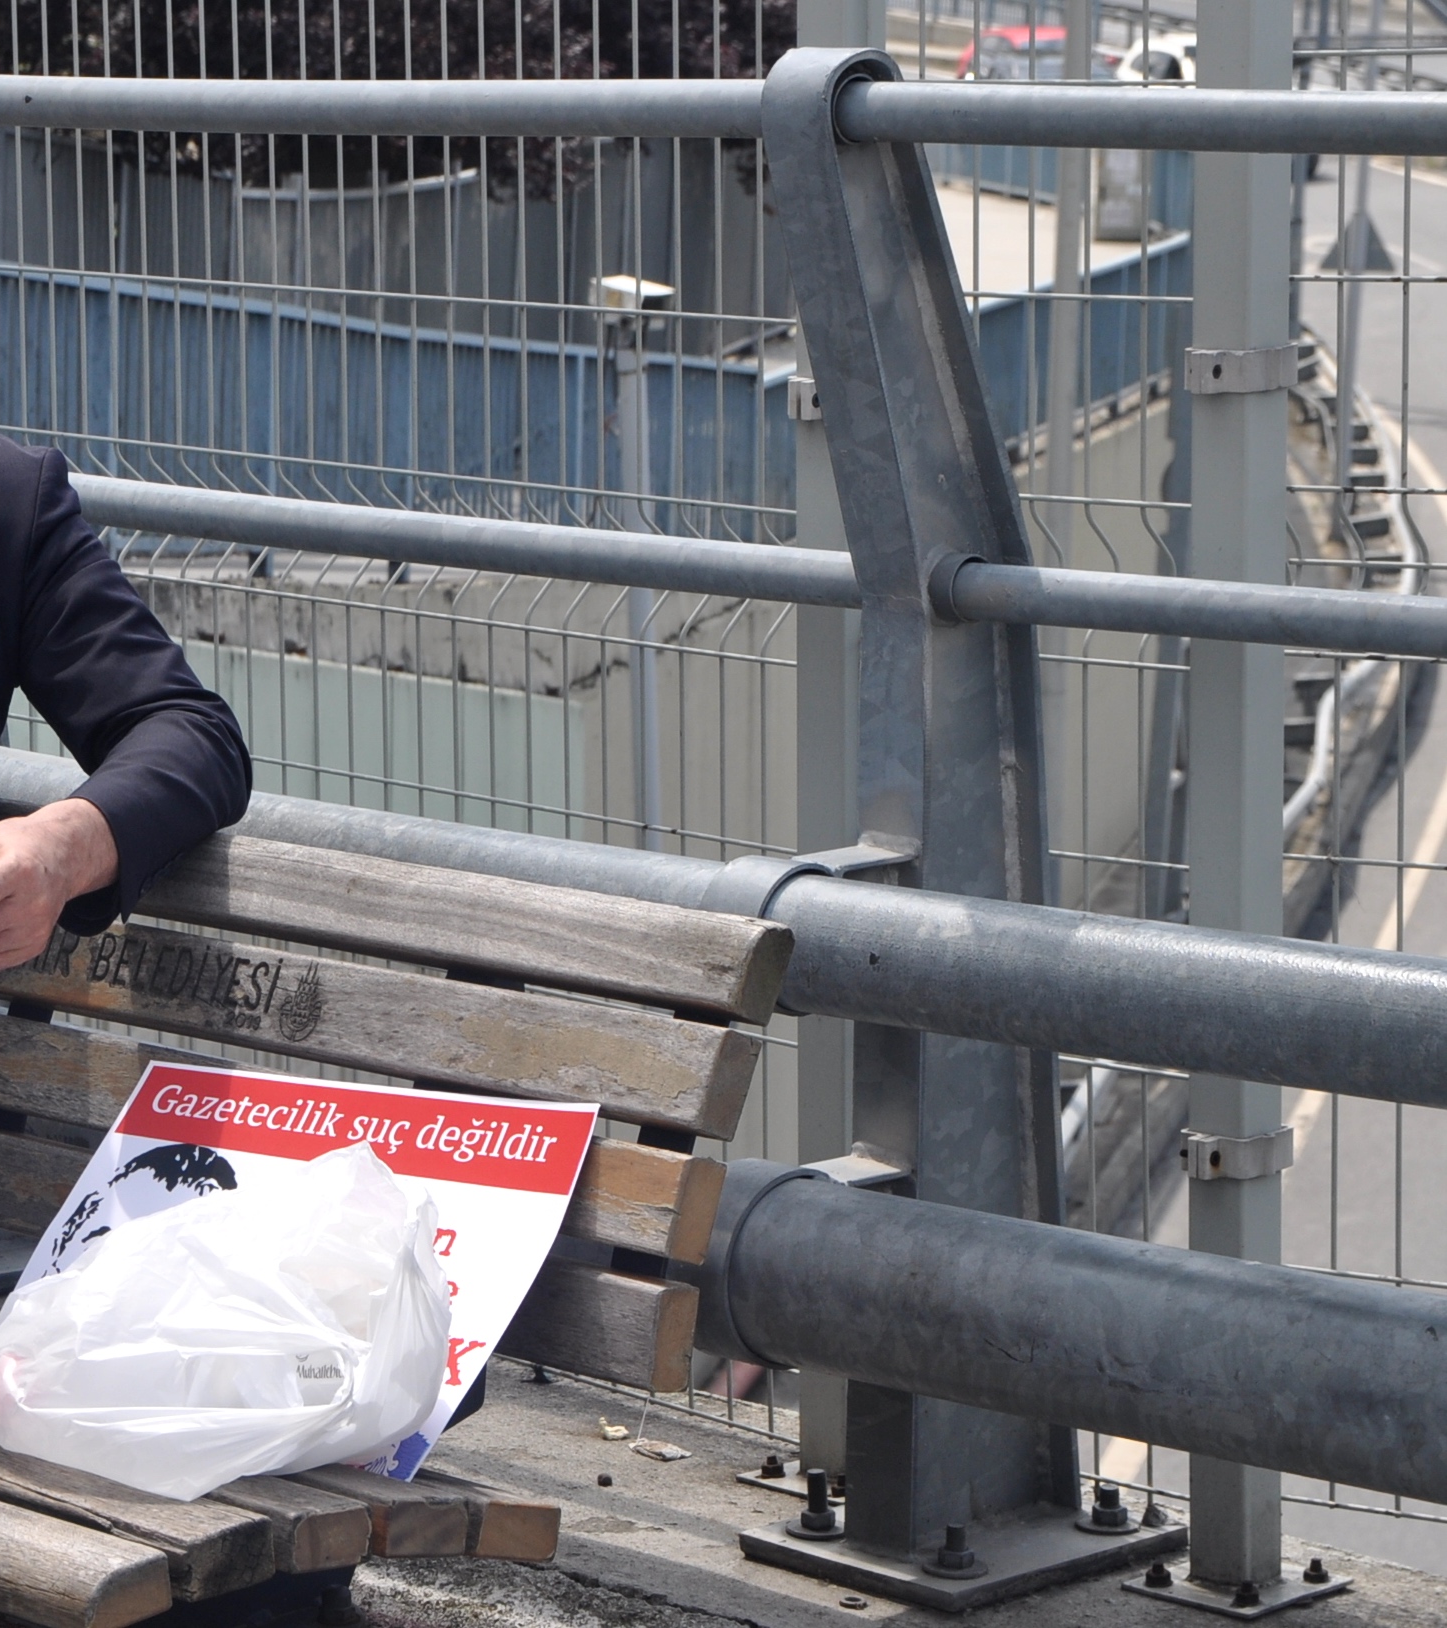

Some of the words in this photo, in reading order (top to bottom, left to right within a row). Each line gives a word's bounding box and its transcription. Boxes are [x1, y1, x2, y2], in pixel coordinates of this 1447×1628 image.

[90, 932, 284, 1014] BELEDİYESİ
[152, 1084, 342, 1139] Gazetecilik
[347, 1117, 412, 1155] suç
[415, 1115, 558, 1163] değildir
